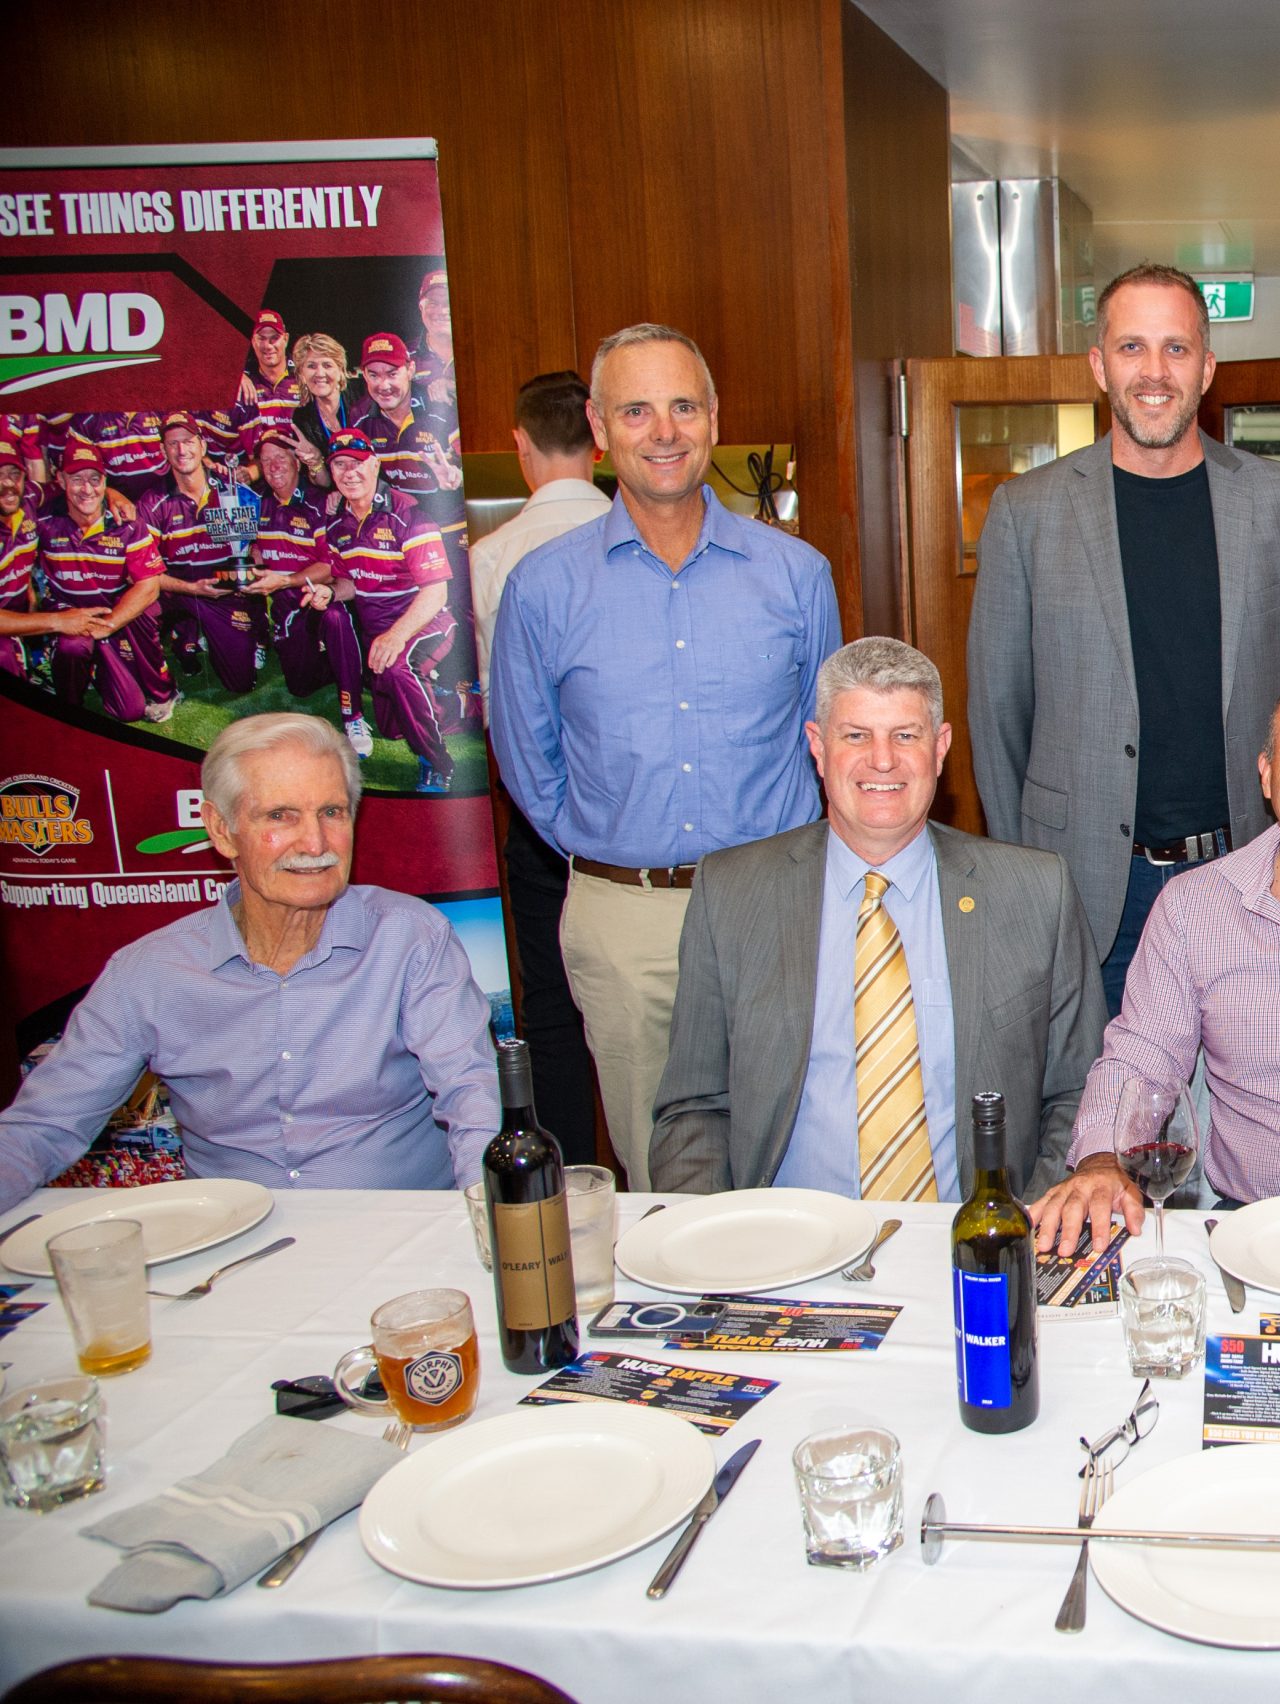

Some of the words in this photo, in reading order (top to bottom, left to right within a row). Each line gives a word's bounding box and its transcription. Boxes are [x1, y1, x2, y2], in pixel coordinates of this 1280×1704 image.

[0, 193, 54, 238] SEE
[60, 191, 175, 236] THINGS
[182, 185, 383, 234] DIFFERENTLY
[0, 292, 165, 355] BMD
[1, 795, 71, 818] BULLS
[0, 820, 93, 844] MASTERS
[1, 880, 88, 908] Supporting
[91, 879, 199, 908] Queensland
[502, 1261, 541, 1272] O'LEARY
[774, 1337, 829, 1349] HUGE
[966, 1333, 1006, 1346] WALKER
[1221, 1340, 1244, 1353] $50
[414, 1360, 453, 1377] FURPHY
[617, 1358, 672, 1376] HUGE
[666, 1367, 742, 1387] RAFFLE
